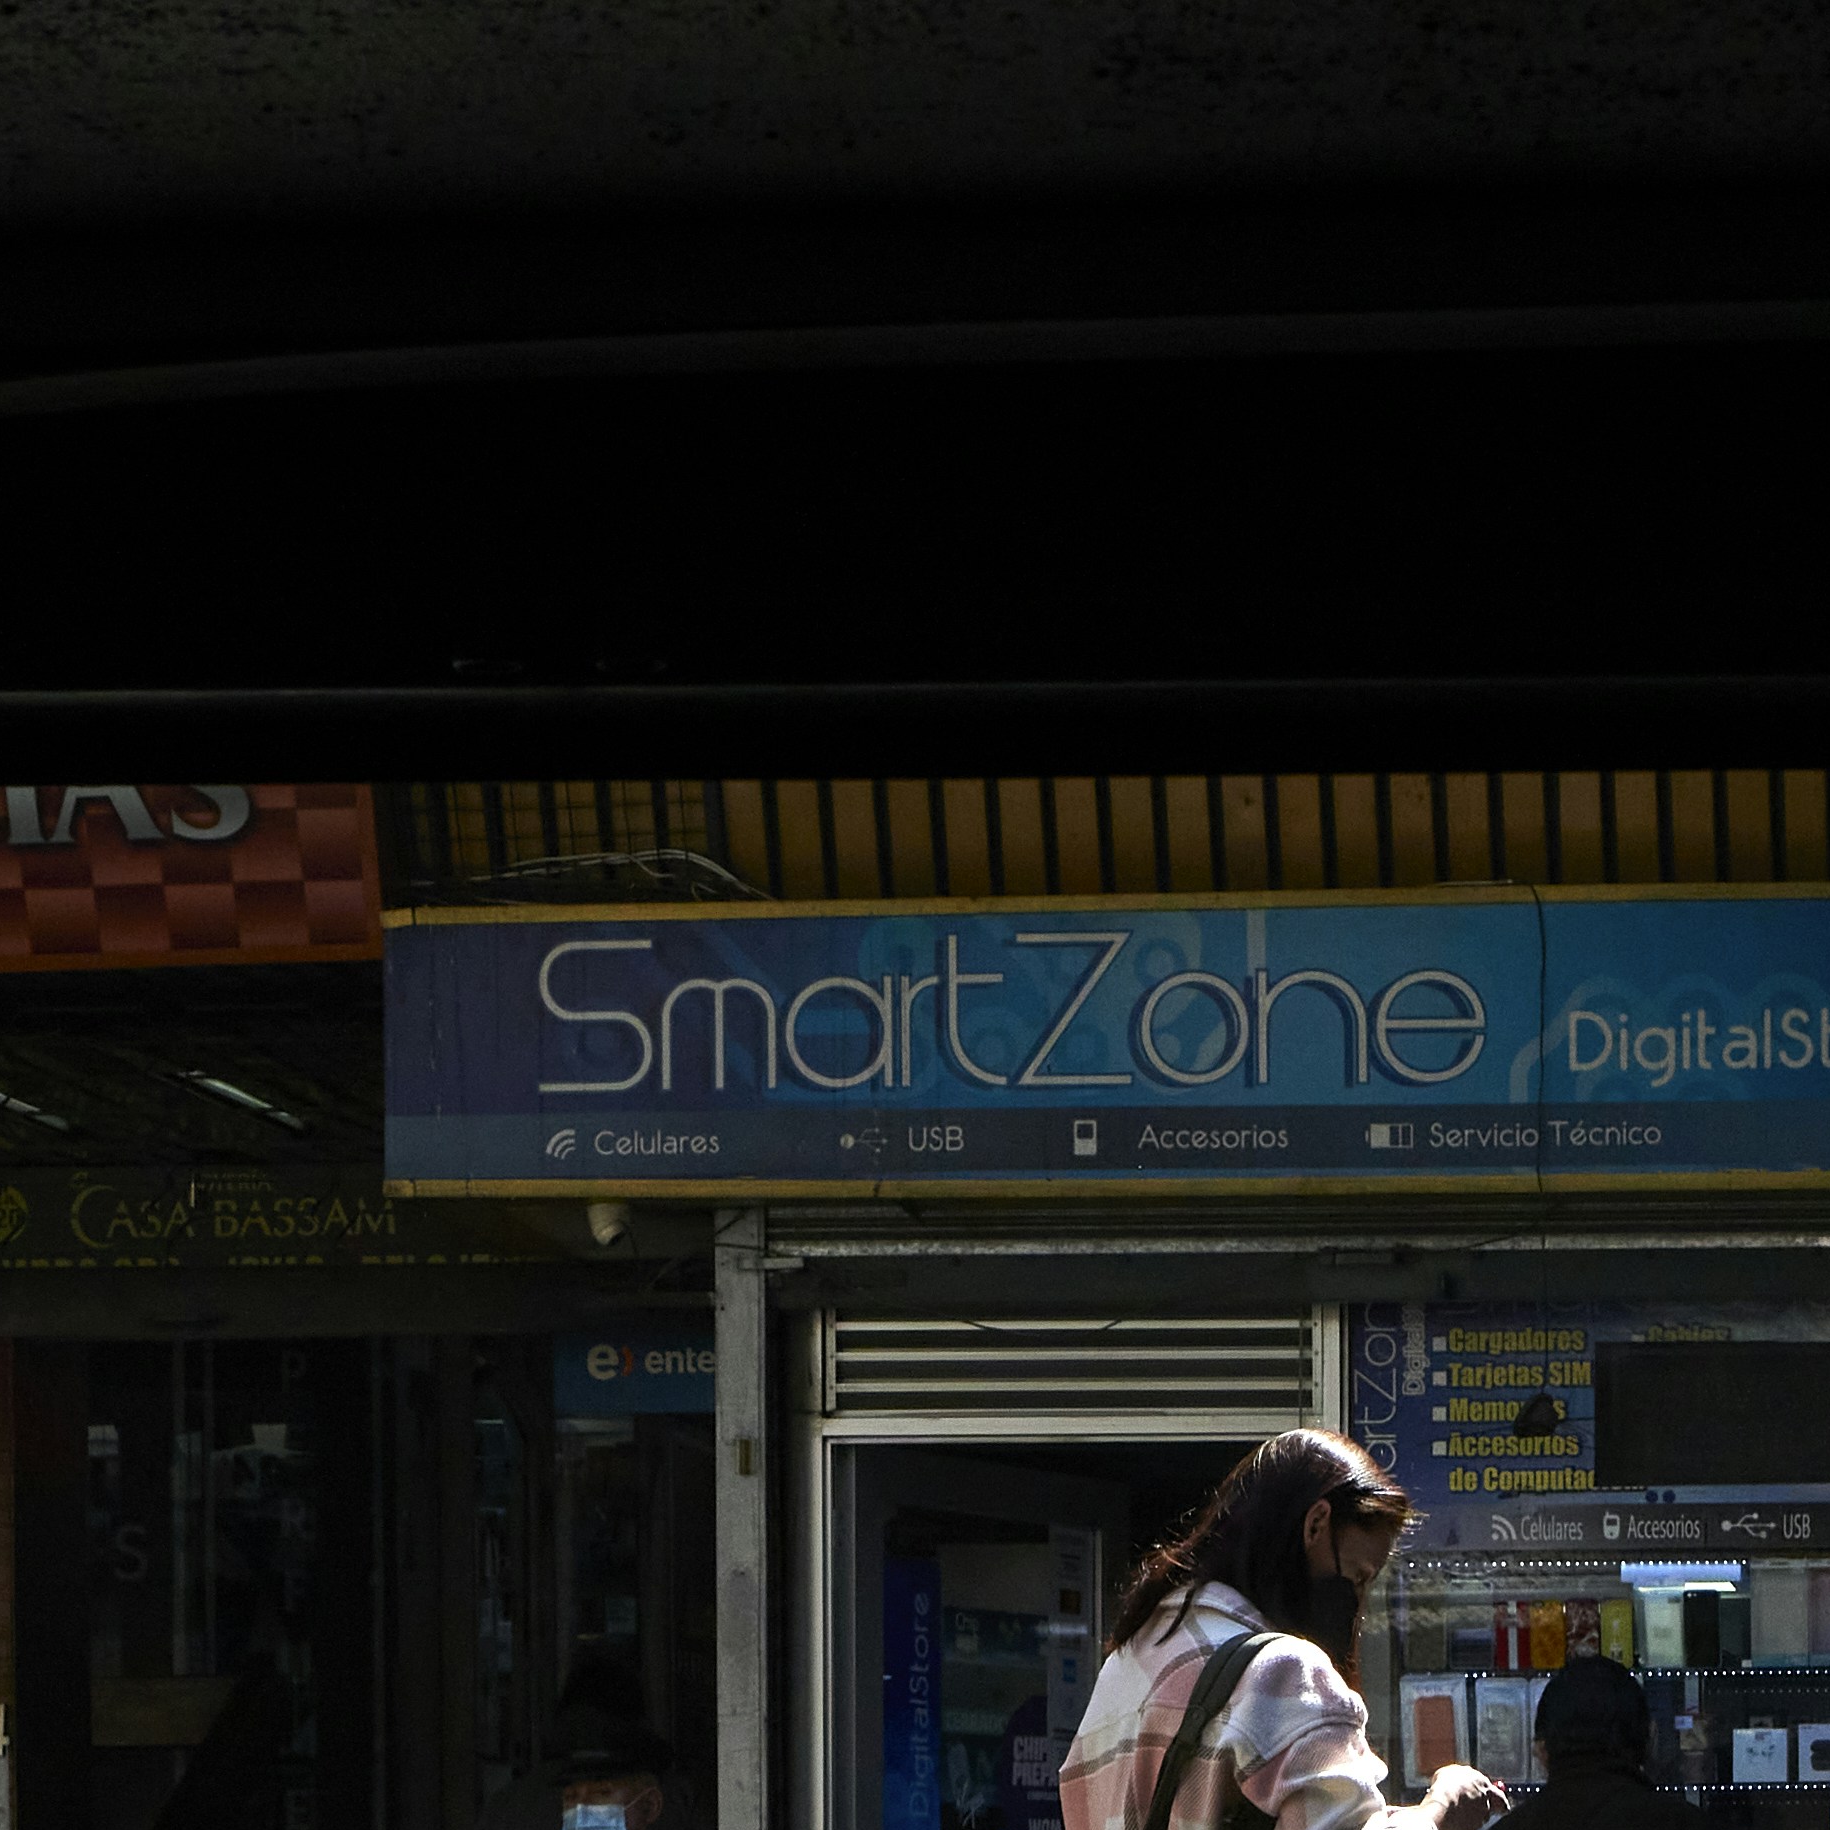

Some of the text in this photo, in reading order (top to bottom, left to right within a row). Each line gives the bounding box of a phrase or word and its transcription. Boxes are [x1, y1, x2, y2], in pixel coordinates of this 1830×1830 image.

[538, 930, 1487, 1093] SmartZone
[592, 1127, 721, 1156] Celulares
[907, 1125, 965, 1154] USB
[1136, 1123, 1289, 1151] Accesorios
[1428, 1118, 1662, 1149] Servicio Técnico
[212, 1197, 397, 1240] BASSAM
[1448, 1327, 1586, 1355] Cargadores
[643, 1344, 716, 1375] ente
[1448, 1361, 1592, 1389] Tarjetas SIM
[1448, 1399, 1567, 1422] Memos
[1448, 1467, 1478, 1492] de
[1519, 1515, 1583, 1543] Celulares
[1626, 1514, 1701, 1541] Accesorios
[1782, 1512, 1812, 1539] USB
[905, 1590, 939, 1818] DigitalStore
